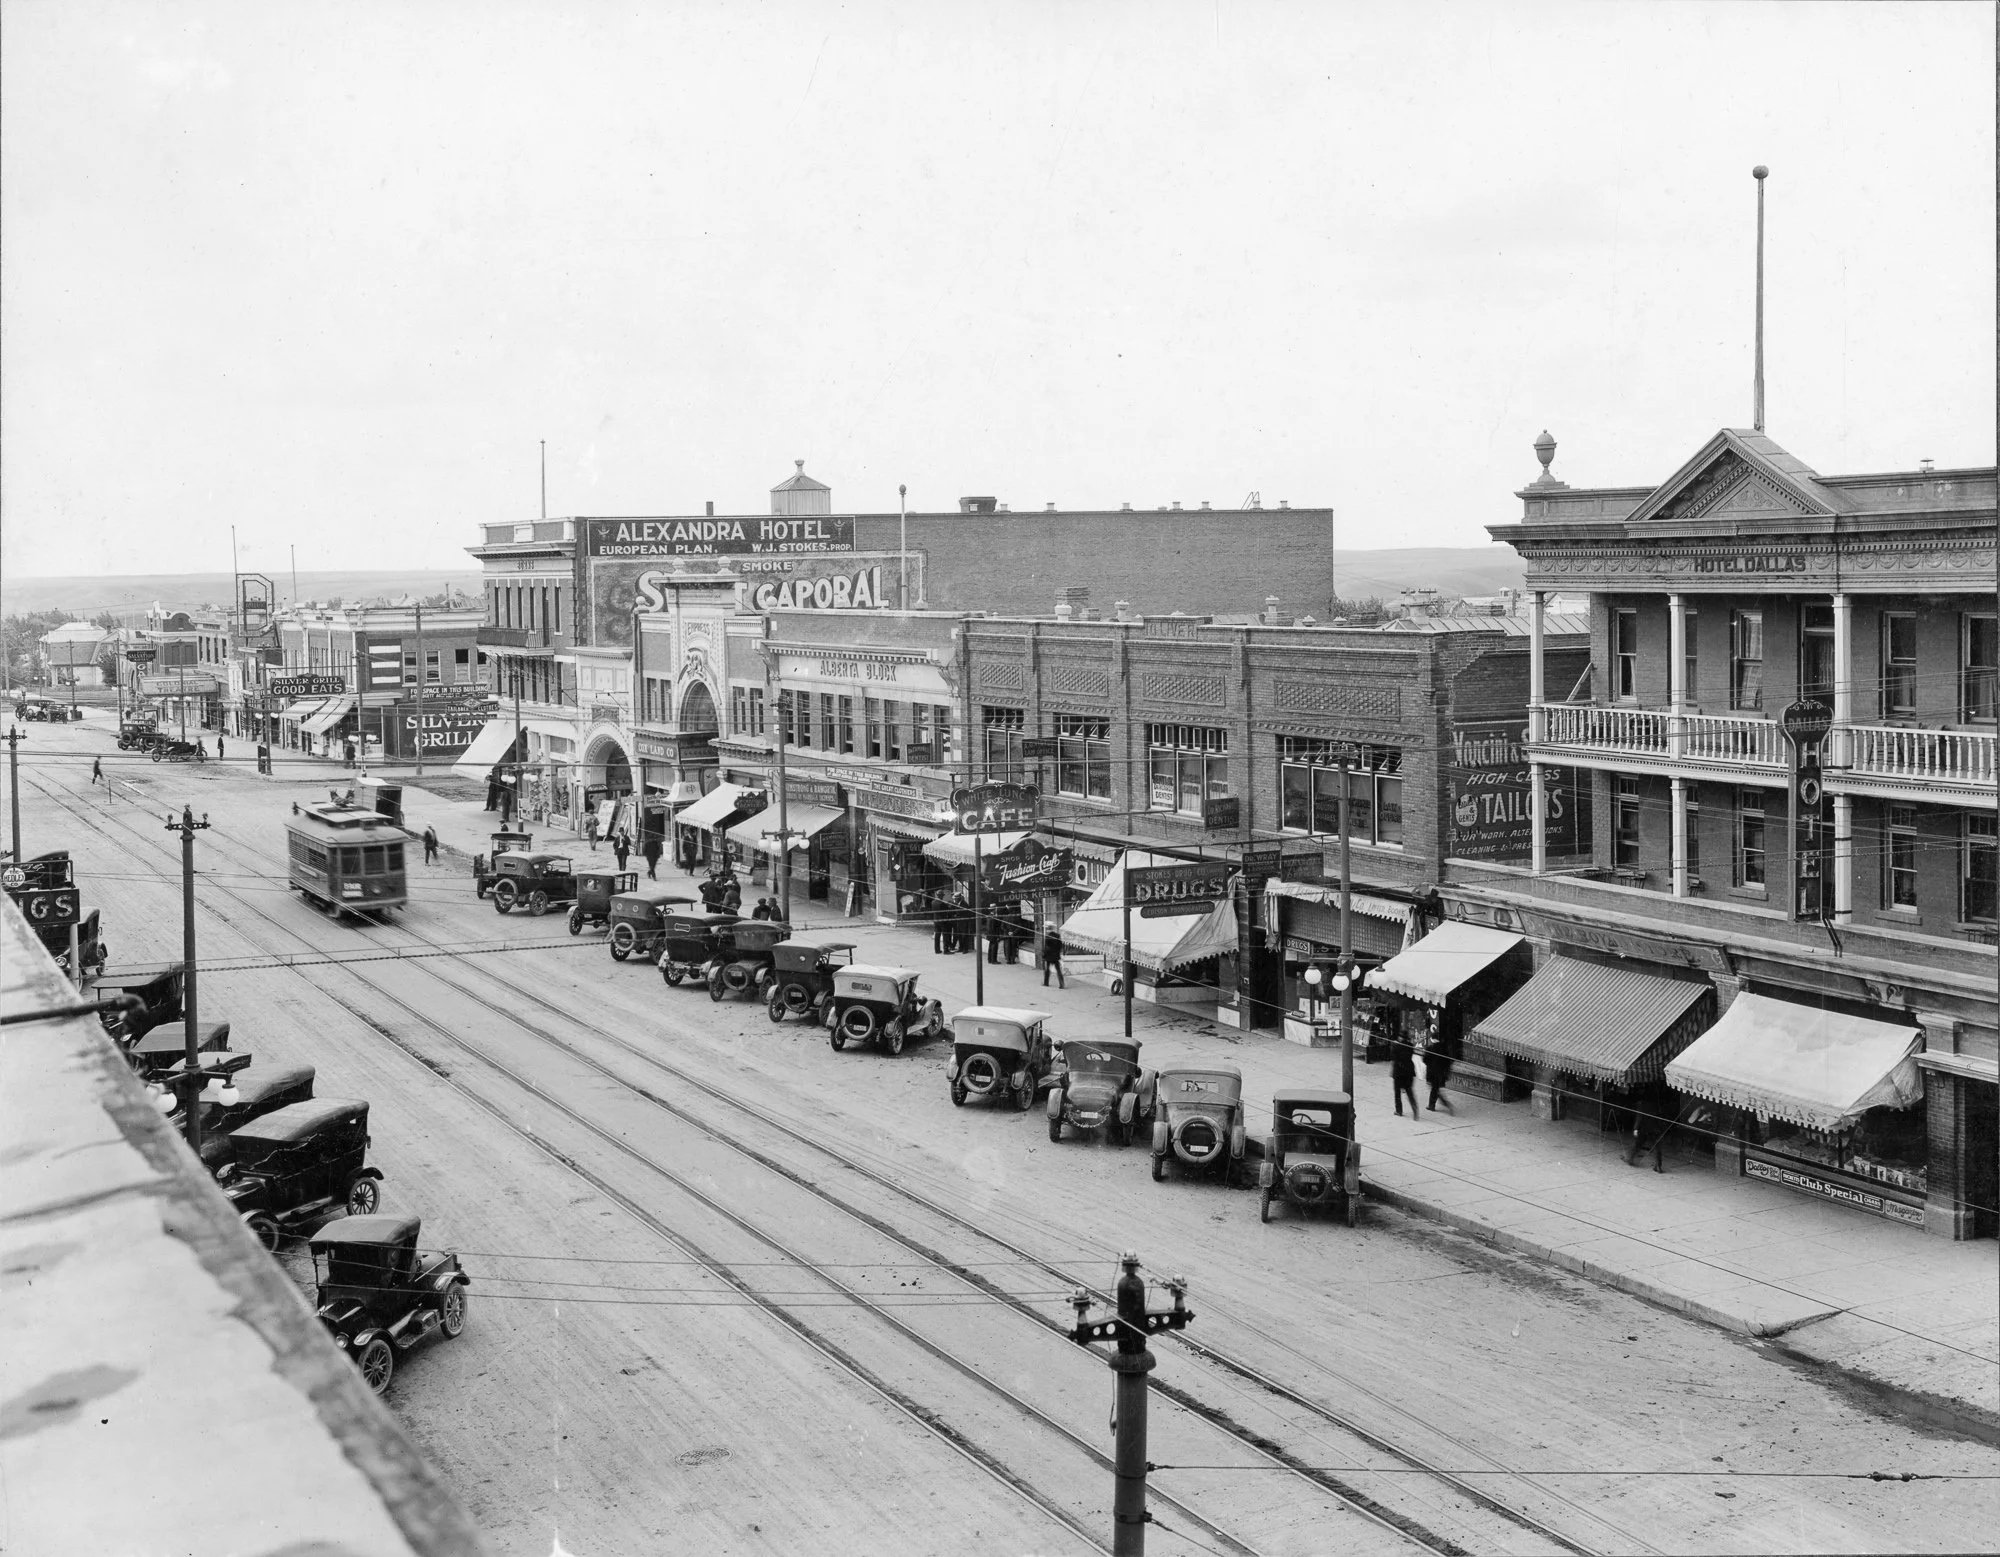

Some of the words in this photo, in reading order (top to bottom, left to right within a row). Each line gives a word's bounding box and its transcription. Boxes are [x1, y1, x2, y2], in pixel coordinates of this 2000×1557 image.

[615, 520, 746, 543] ALEXANDRA
[760, 520, 831, 541] HOTEL
[599, 544, 668, 556] EUROPEAN
[741, 560, 793, 572] SMOKE
[1694, 556, 1743, 573] HOTEL
[1744, 555, 1806, 573] DALLAS
[752, 565, 890, 610] CAPORAL
[820, 660, 860, 679] ALBERTA
[866, 663, 897, 682] BLOCK
[274, 678, 309, 686] SILVER
[312, 677, 340, 685] GRILL
[272, 685, 306, 695] GOOD
[311, 683, 342, 694] EATS
[463, 685, 489, 693] BUILDING
[406, 712, 488, 730] SILVER
[1788, 716, 1829, 733] DALLAS
[649, 743, 665, 756] LAND
[1466, 771, 1509, 785] HIGH
[1515, 769, 1561, 783] CLSS
[961, 789, 993, 806] WHITE
[1002, 787, 1032, 803] LUNC
[1155, 791, 1173, 801] DENTIST
[961, 807, 1034, 831] CAFE
[1800, 741, 1820, 916] HOTEL
[1456, 845, 1497, 856] CLEANING
[1025, 854, 1035, 862] OF
[1030, 875, 1063, 884] CLOTHES
[1146, 869, 1172, 880] STOKES
[1004, 891, 1029, 901] LOUIS
[1135, 878, 1224, 902] DRUGS
[1286, 938, 1309, 951] DRUGS
[1683, 1076, 1738, 1104] HOTEL
[1746, 1096, 1816, 1124] DALLAS
[1799, 1176, 1823, 1192] Club
[1824, 1183, 1864, 1205] Special
